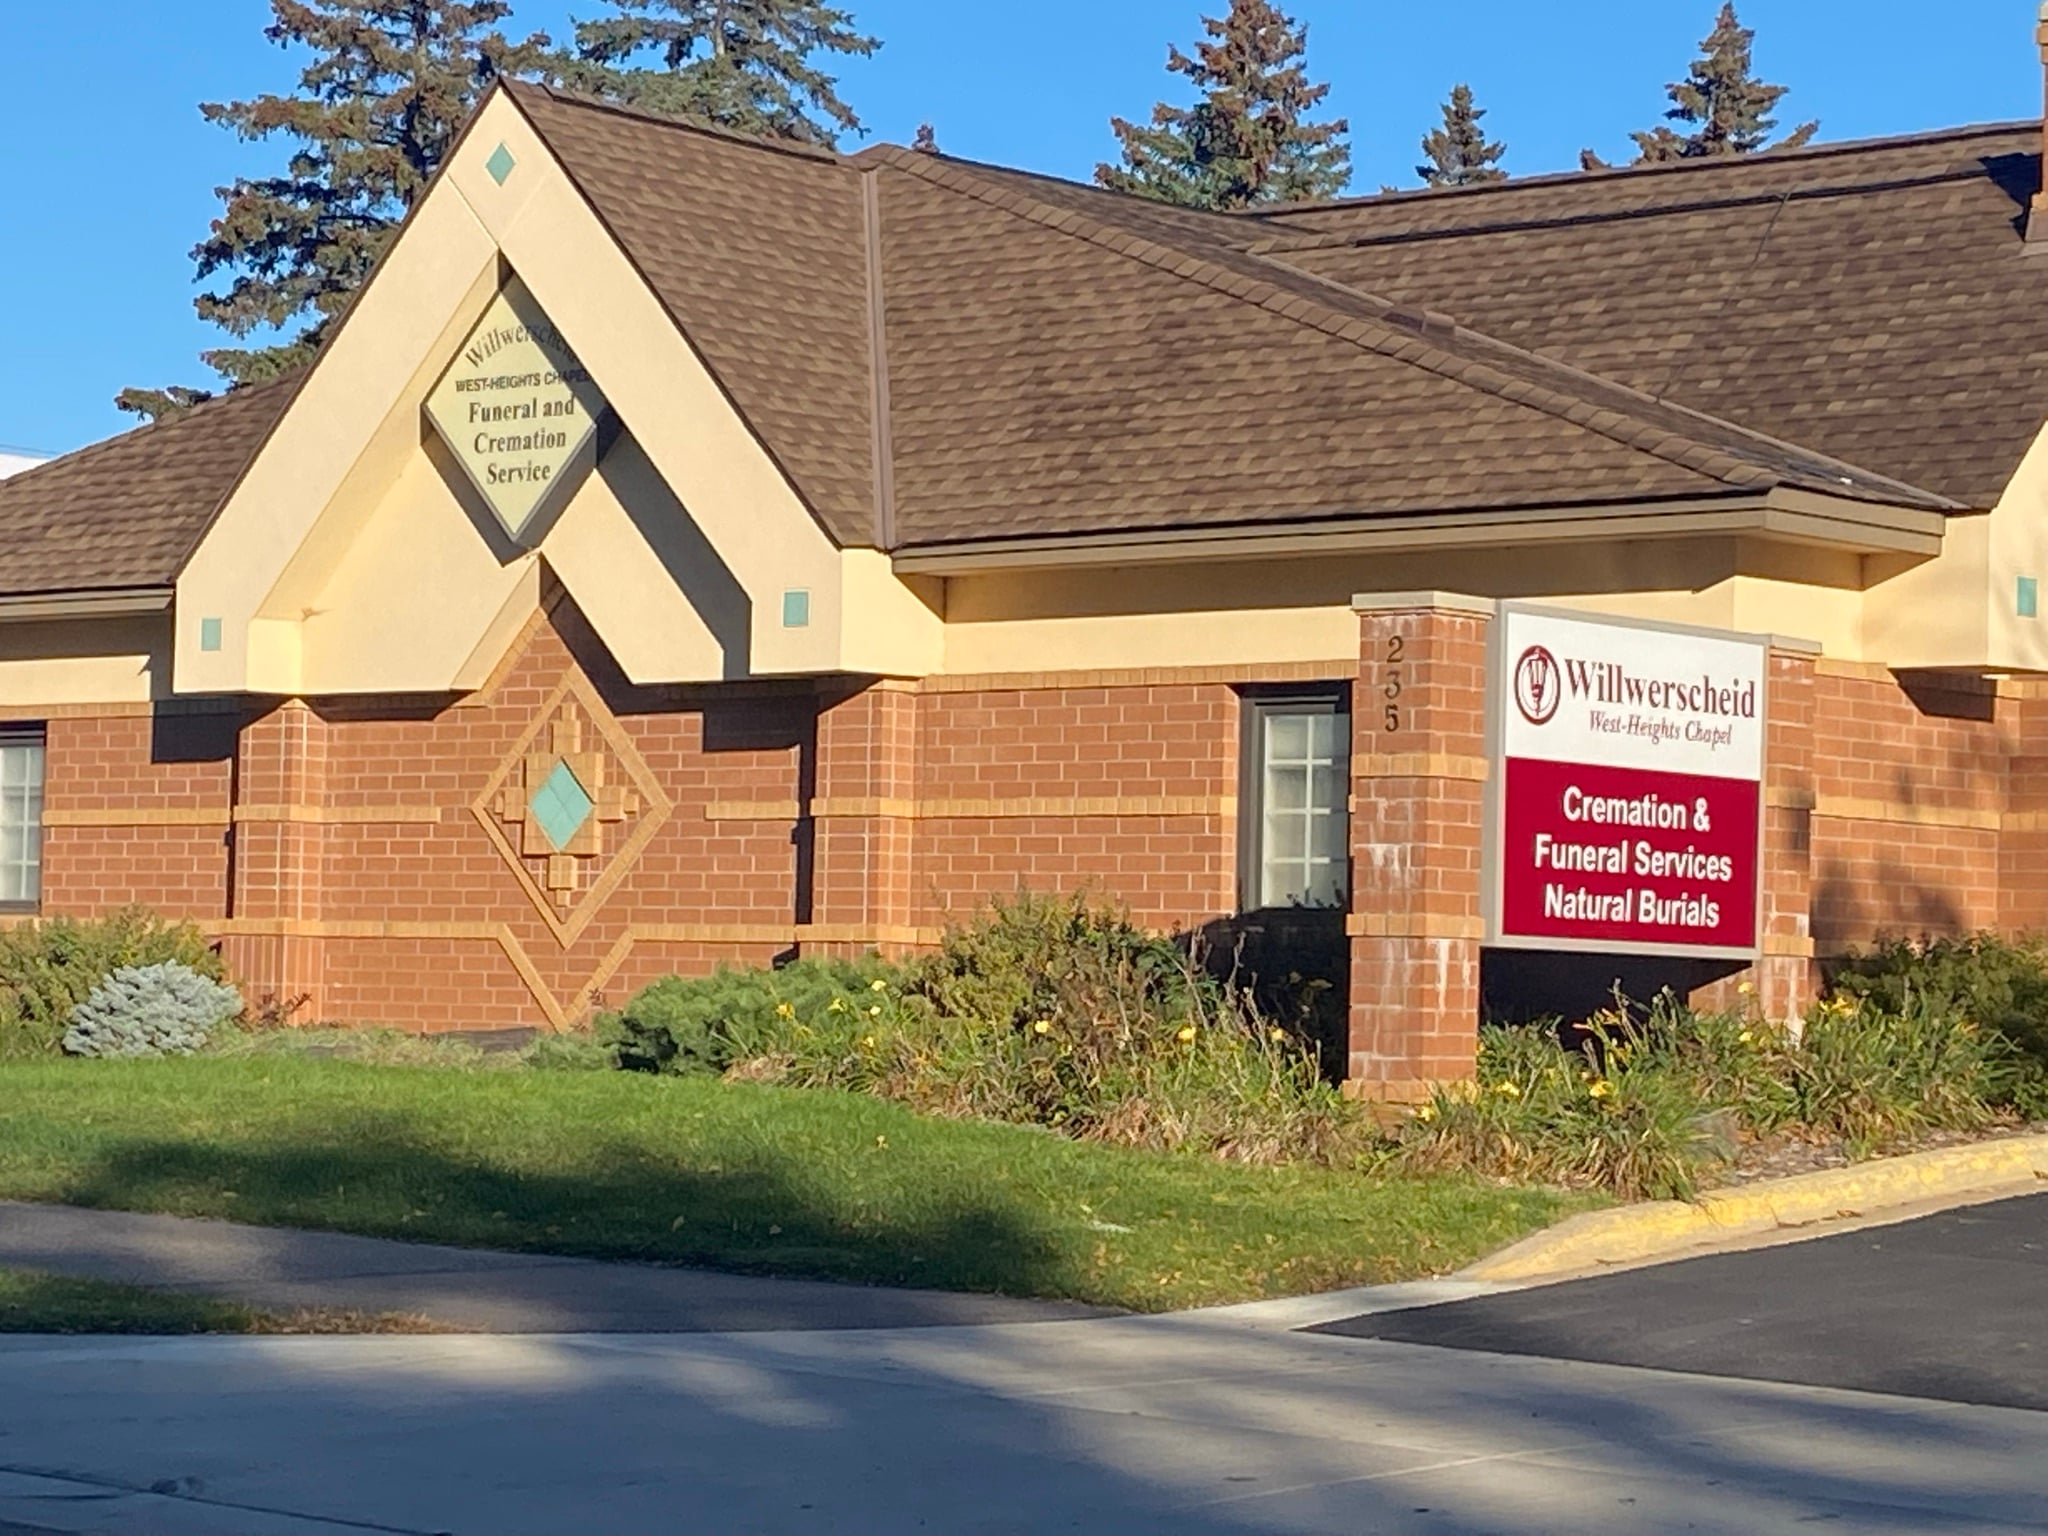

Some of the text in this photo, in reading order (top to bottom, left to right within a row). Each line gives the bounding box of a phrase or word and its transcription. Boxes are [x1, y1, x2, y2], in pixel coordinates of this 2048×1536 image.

[455, 373, 541, 393] WEST-HEIGHTS
[469, 395, 575, 423] Funeral and
[474, 428, 567, 454] Cremation
[487, 461, 551, 485] Service
[1384, 635, 1404, 732] 235
[1565, 658, 1755, 719] Willwerscheid
[1590, 709, 1733, 751] West-Heights Chapel
[1563, 785, 1711, 832] Cremation &
[1534, 833, 1733, 882] Funeral Services
[1544, 883, 1720, 928] Natural Burials
